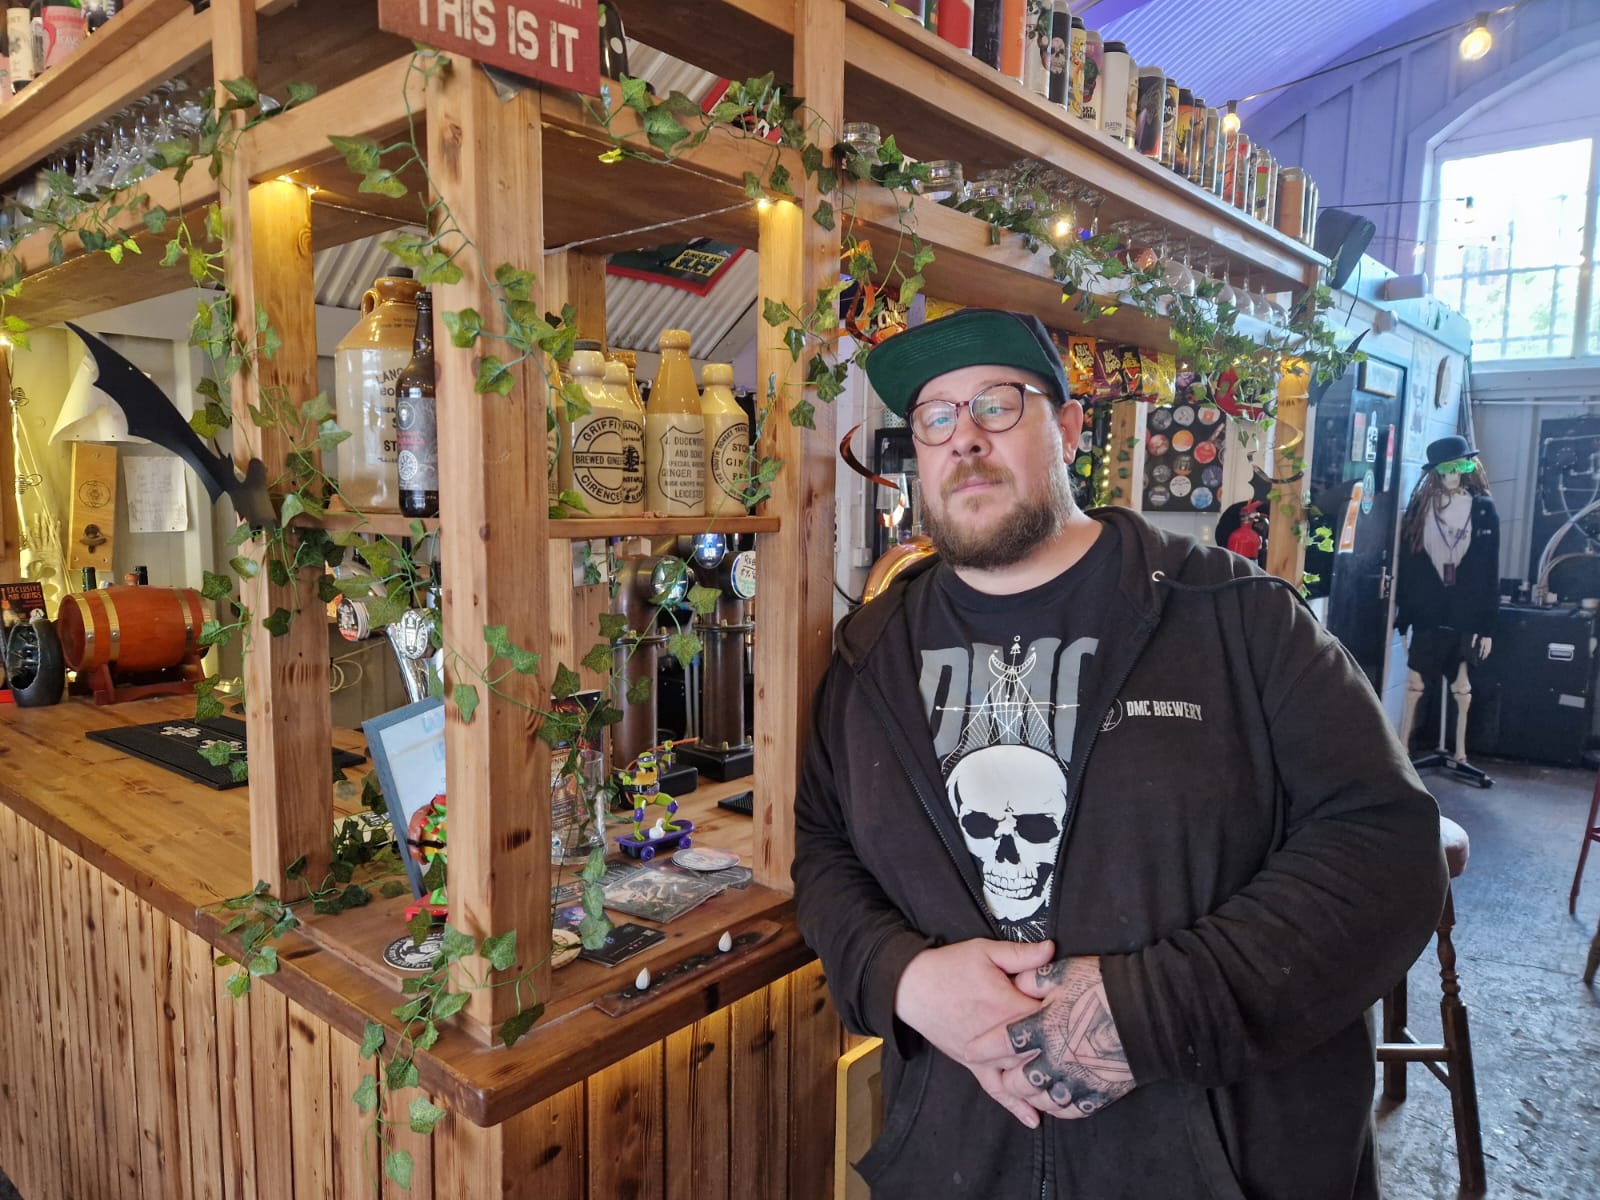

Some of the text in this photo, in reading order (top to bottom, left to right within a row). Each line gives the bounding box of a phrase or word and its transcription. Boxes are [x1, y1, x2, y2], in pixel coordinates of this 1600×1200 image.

[418, 0, 579, 72] THIS IS IT
[575, 455, 605, 466] BREWED
[675, 450, 689, 459] AND
[1126, 700, 1203, 721] DMC BREWERY
